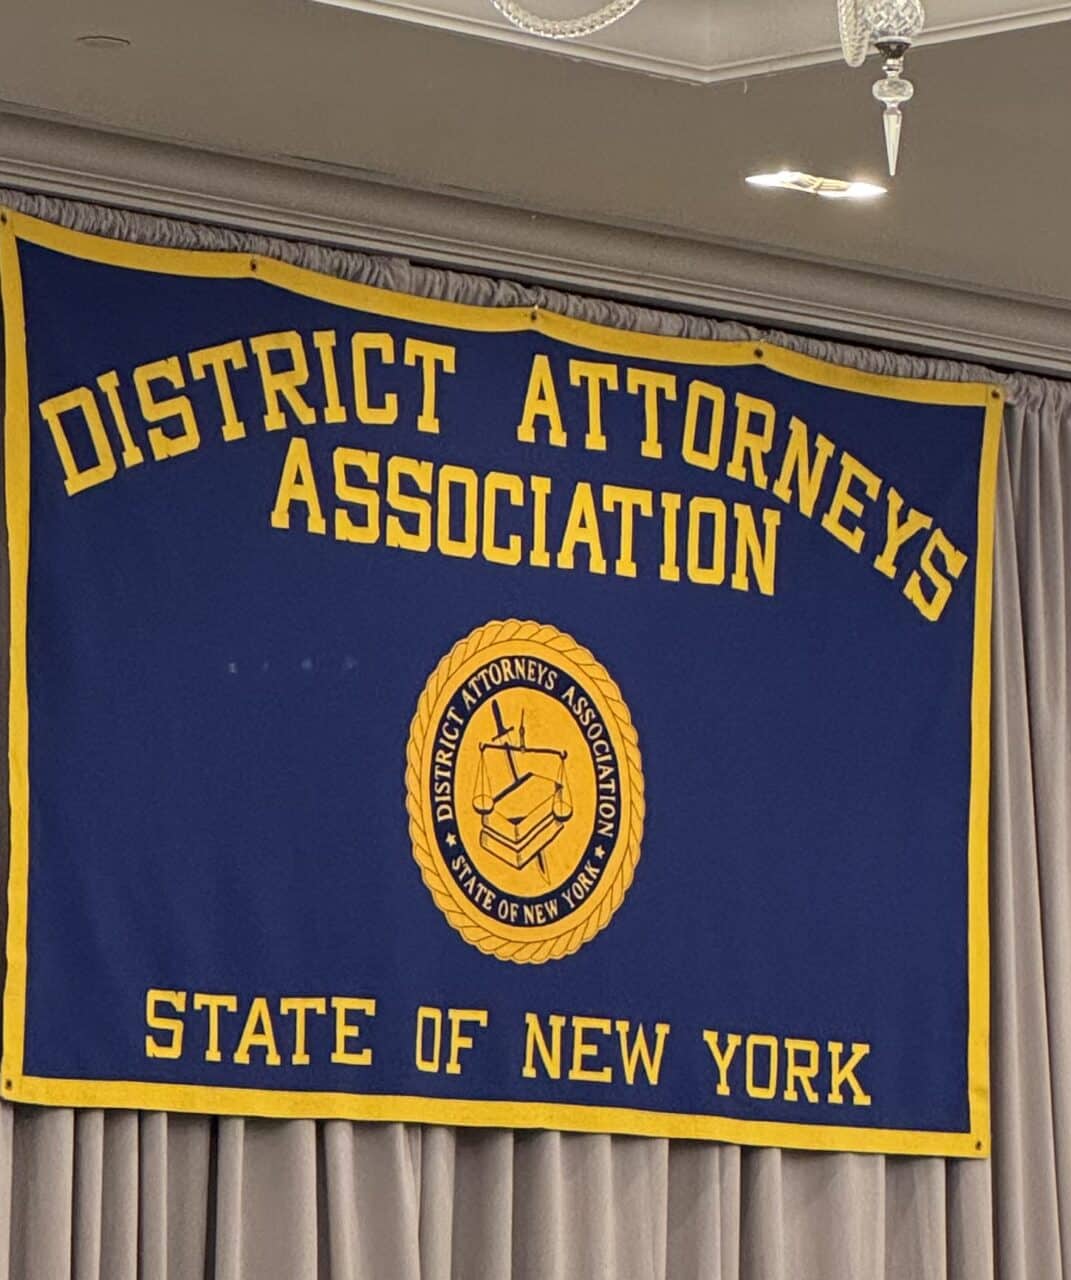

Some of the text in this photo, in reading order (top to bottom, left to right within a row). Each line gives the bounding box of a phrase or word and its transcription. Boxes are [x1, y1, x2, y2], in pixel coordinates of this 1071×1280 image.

[38, 330, 968, 622] DISTRICT ATTORNEYS
[270, 436, 781, 597] ASSOCIATION
[434, 657, 618, 838] DISTRICT ATTORNEYS ASSOCIATION
[451, 855, 601, 926] STATE OF NEW YORK
[145, 989, 872, 1106] STATE OF NEW YORK
